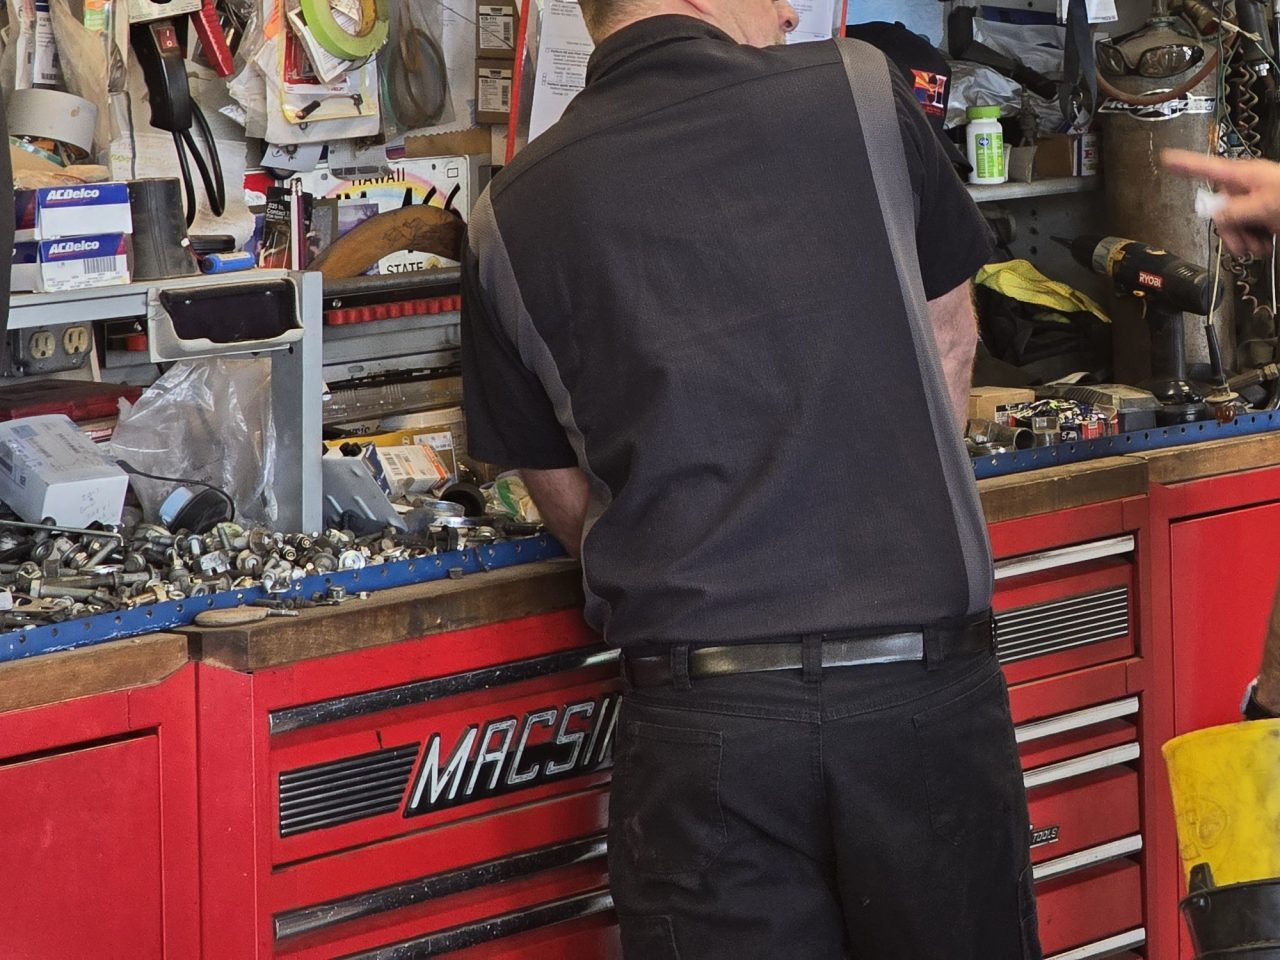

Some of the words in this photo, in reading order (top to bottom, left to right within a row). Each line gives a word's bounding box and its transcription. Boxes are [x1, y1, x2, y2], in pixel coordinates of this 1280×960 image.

[46, 188, 100, 201] ACDelco
[48, 240, 100, 255] ACDelco
[386, 261, 423, 273] STATE
[1139, 272, 1161, 288] RYOBI
[1032, 827, 1058, 843] TOOLS
